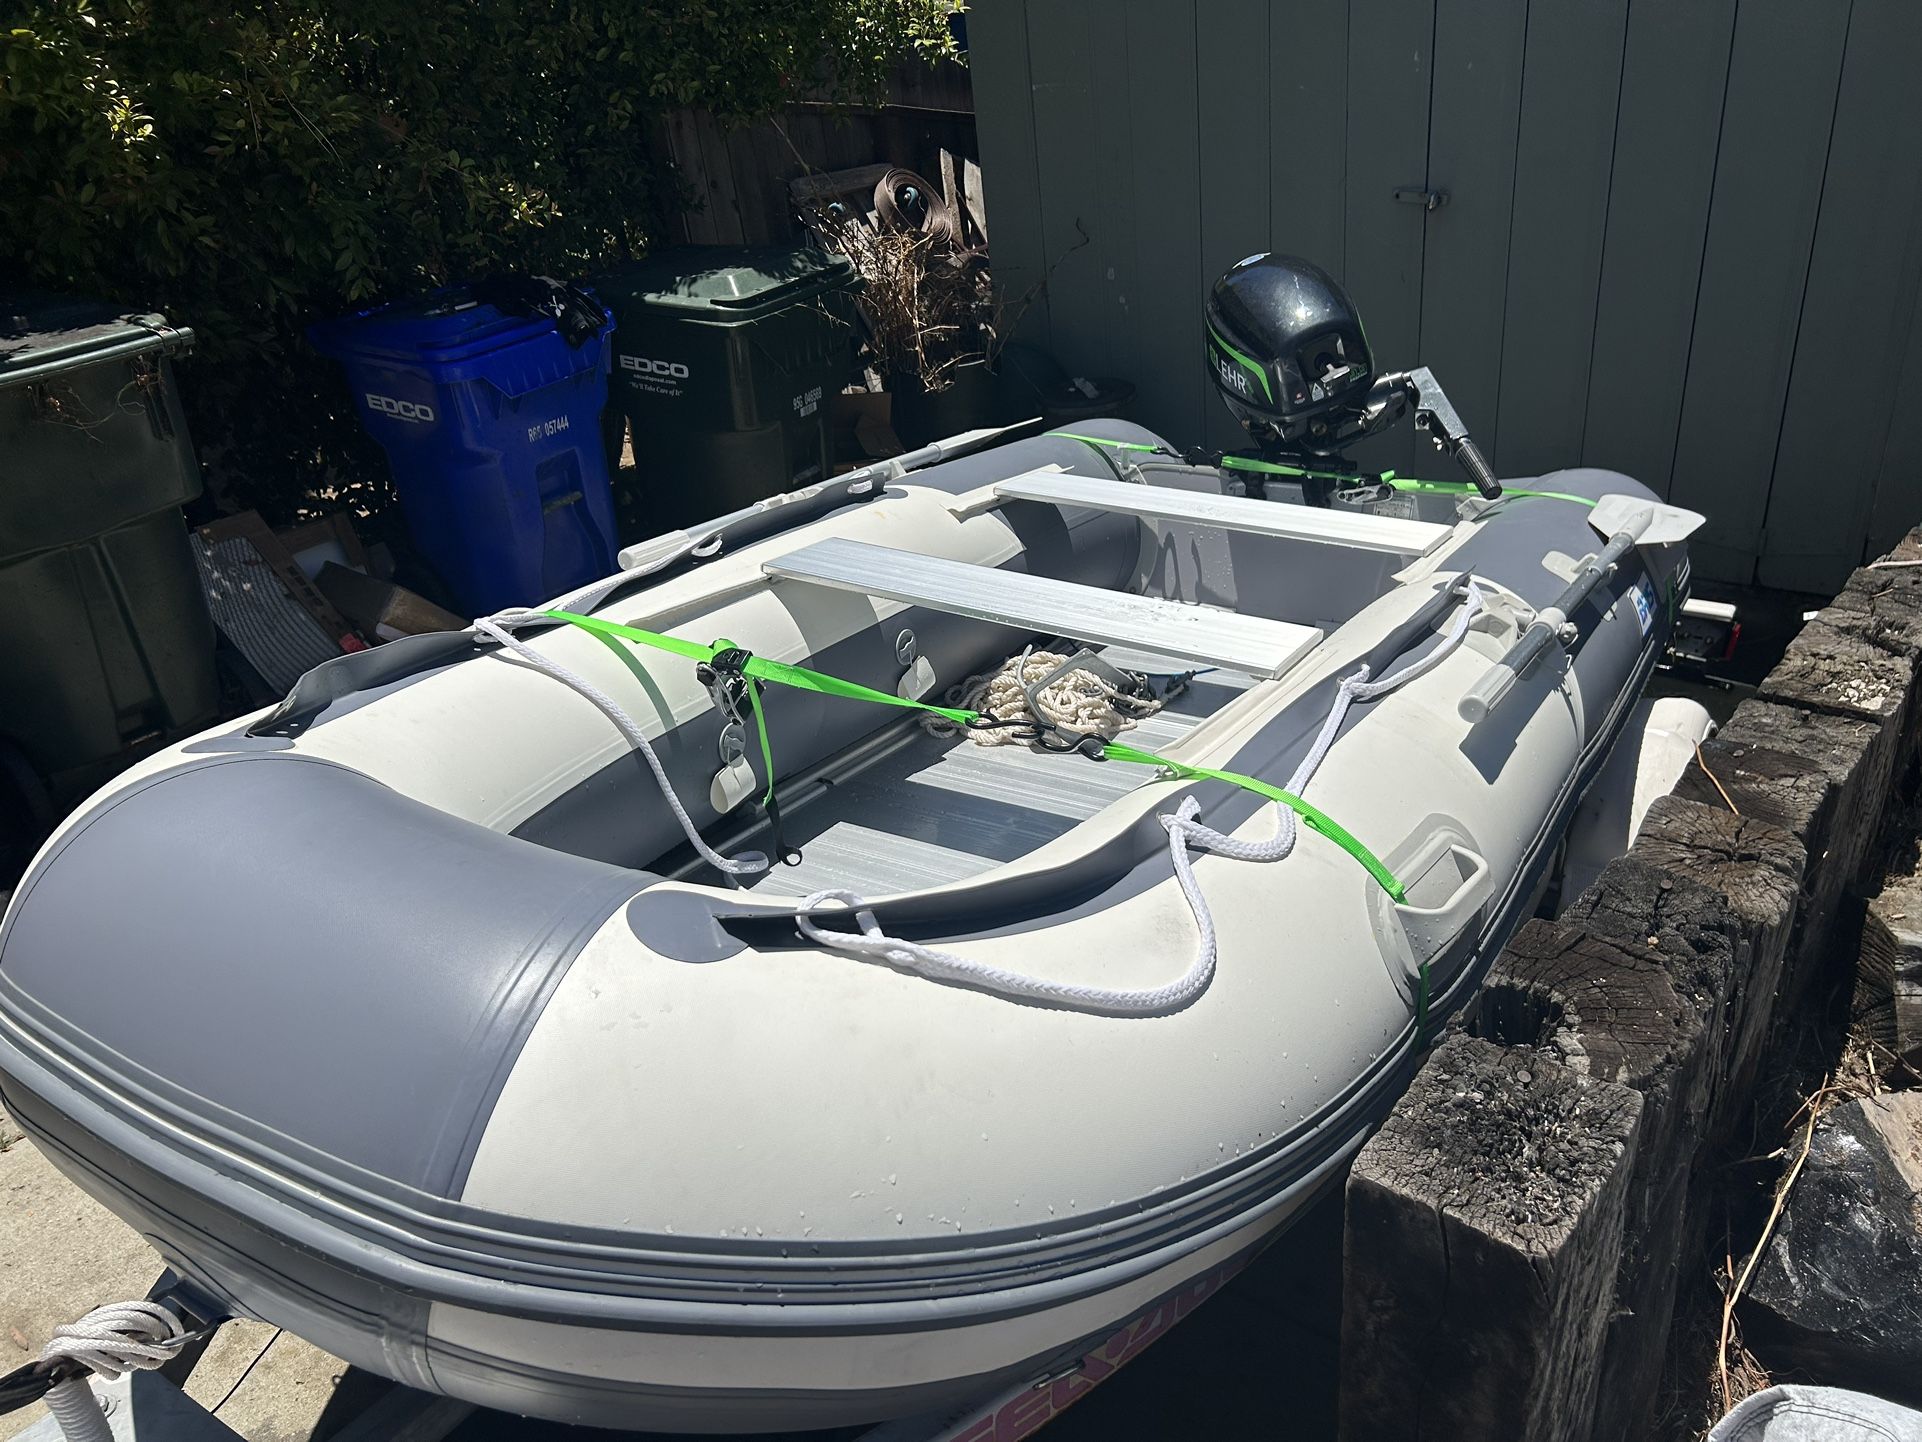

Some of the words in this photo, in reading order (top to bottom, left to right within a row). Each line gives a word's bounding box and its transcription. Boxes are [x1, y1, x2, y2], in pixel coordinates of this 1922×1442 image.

[620, 354, 689, 378] EDCO
[1215, 353, 1247, 395] LEHR
[365, 393, 435, 422] EDCO
